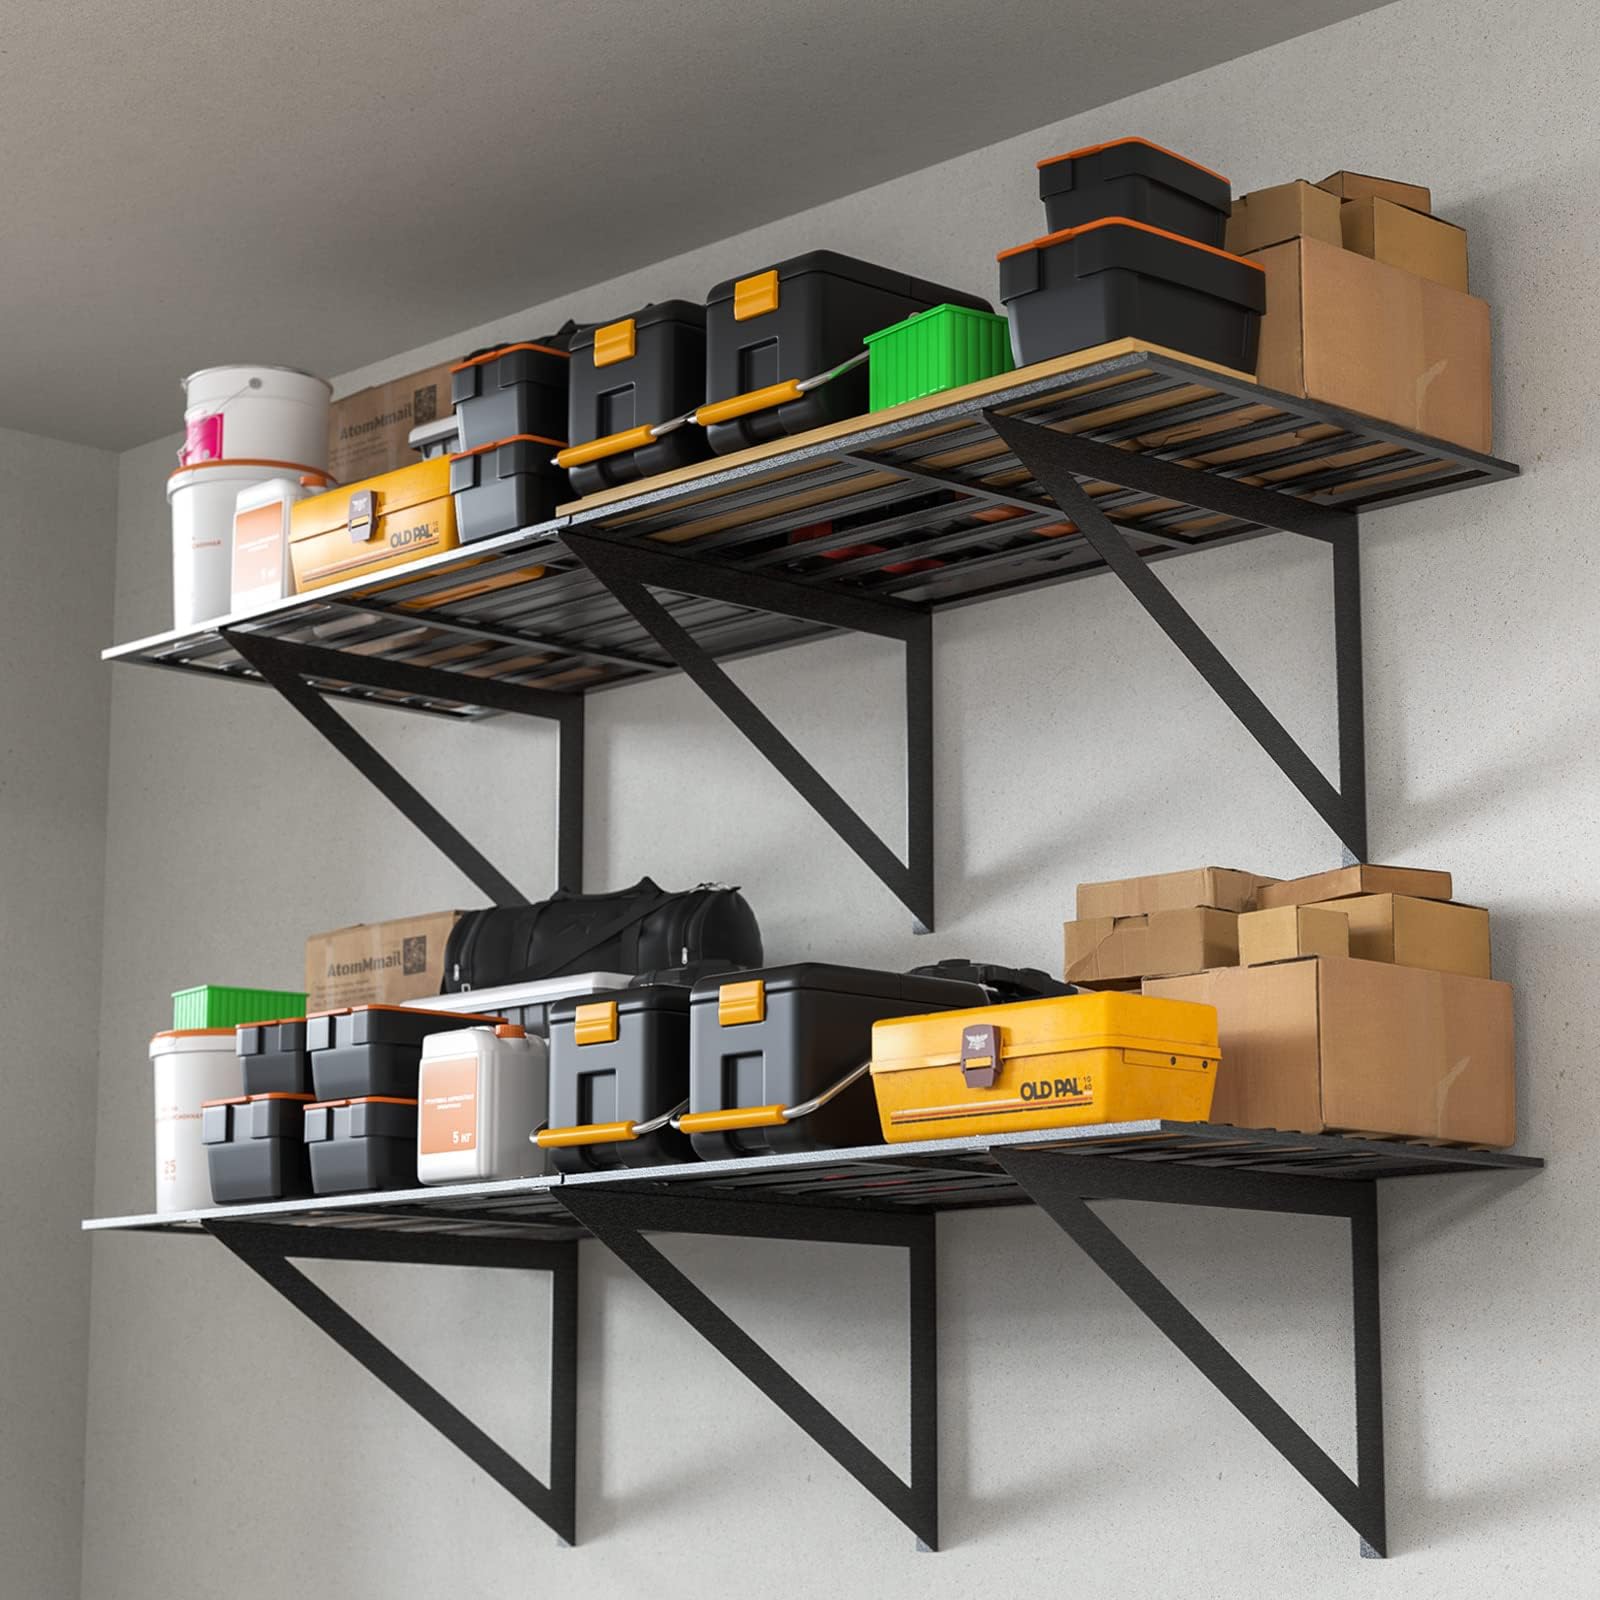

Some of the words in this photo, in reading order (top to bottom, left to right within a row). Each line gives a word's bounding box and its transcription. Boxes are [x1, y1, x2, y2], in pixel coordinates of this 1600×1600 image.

[341, 402, 412, 440] AtomMmail
[390, 528, 412, 548] OLD
[413, 523, 433, 542] PAL
[327, 951, 402, 977] AtomMmail
[1020, 1081, 1052, 1101] OLD
[1054, 1077, 1083, 1097] PAL
[452, 1131, 460, 1144] 5
